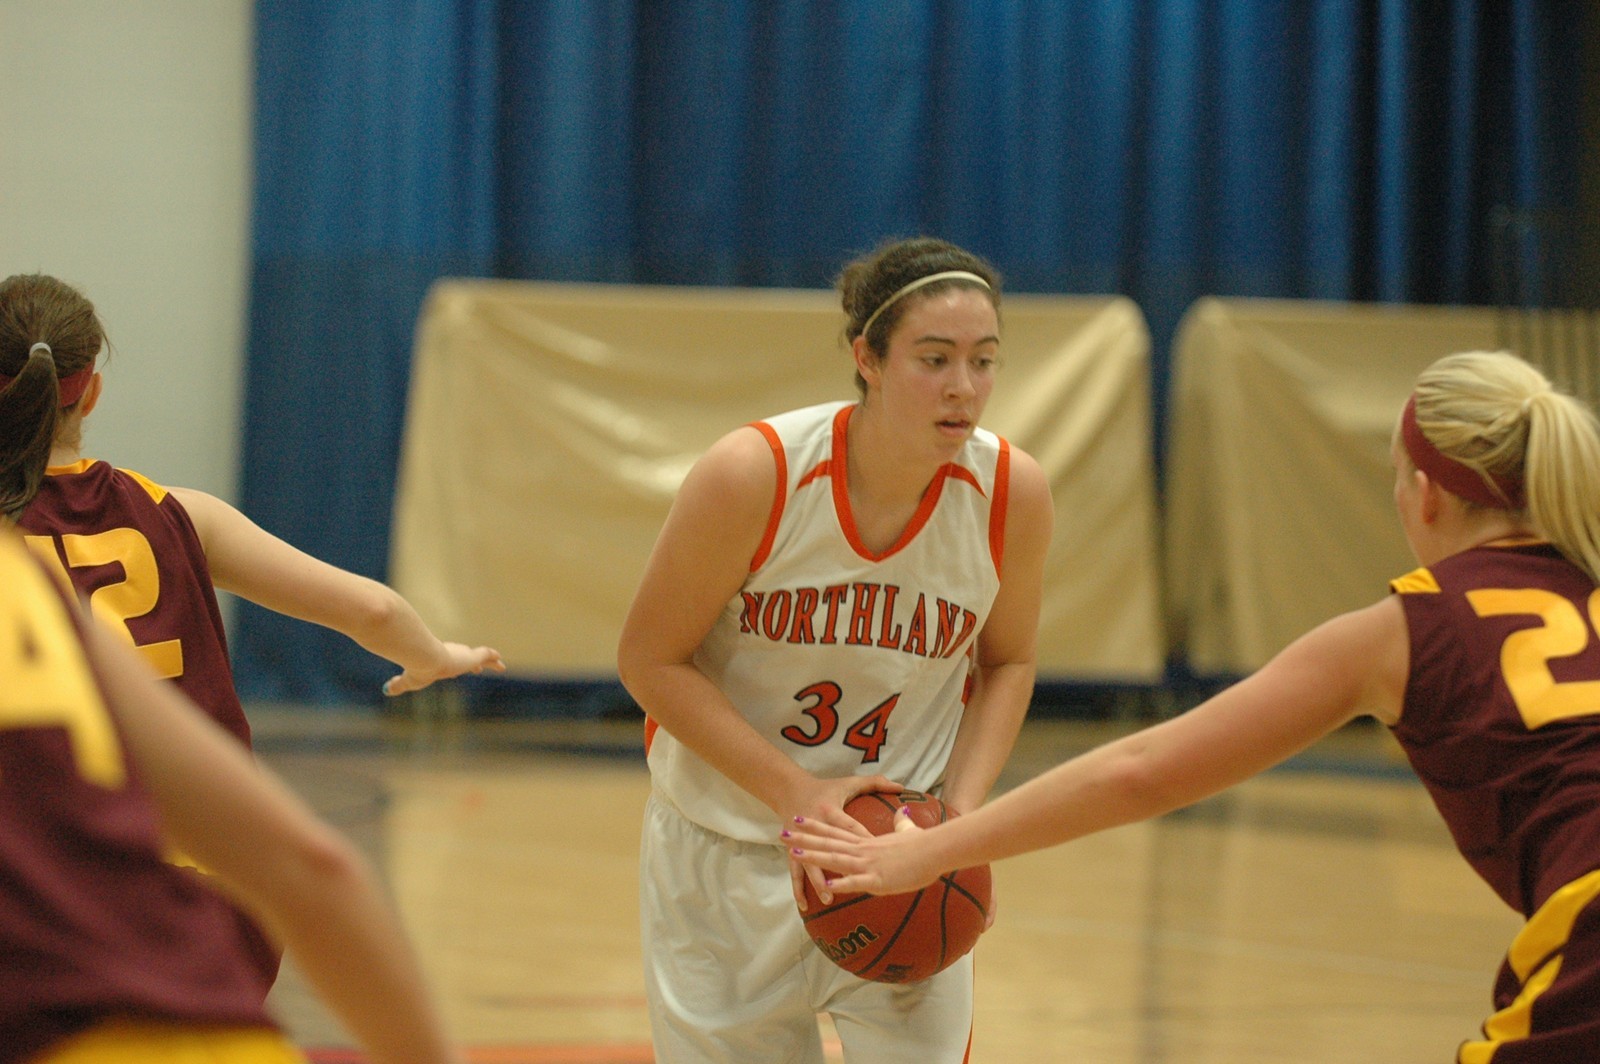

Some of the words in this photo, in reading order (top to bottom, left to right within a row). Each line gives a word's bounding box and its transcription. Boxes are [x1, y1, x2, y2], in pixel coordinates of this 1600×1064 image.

[740, 582, 977, 659] NORTHLAND
[1465, 587, 1600, 731] 2
[780, 680, 902, 765] 34
[816, 924, 879, 962] lson
